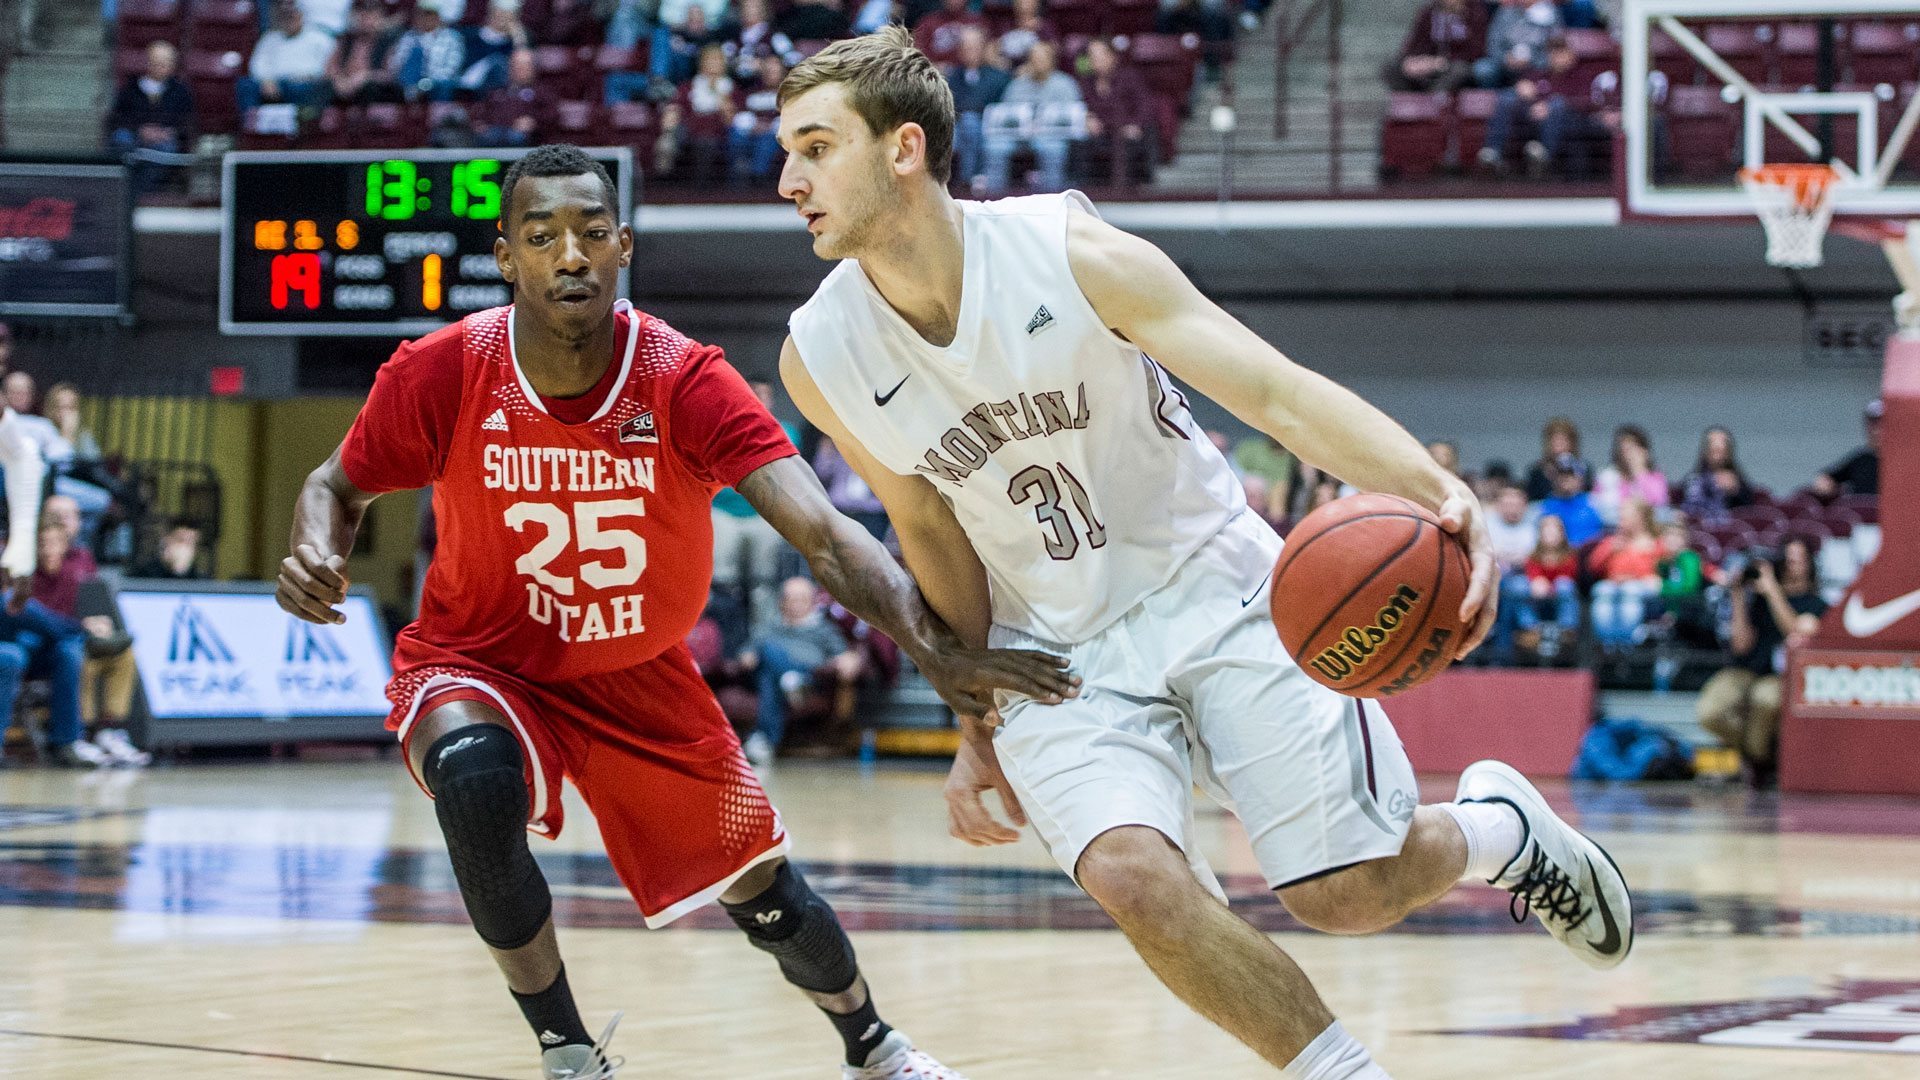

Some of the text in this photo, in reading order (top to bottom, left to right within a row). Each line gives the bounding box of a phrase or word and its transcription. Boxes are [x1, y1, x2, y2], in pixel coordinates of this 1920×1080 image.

[422, 253, 442, 311] 1
[633, 413, 654, 431] SKY
[483, 444, 655, 494] SOUTHERN
[1006, 461, 1107, 561] 31
[503, 497, 647, 596] 25
[525, 583, 645, 643] UTAH
[1307, 583, 1424, 682] Wilson
[1377, 627, 1454, 696] NCAA
